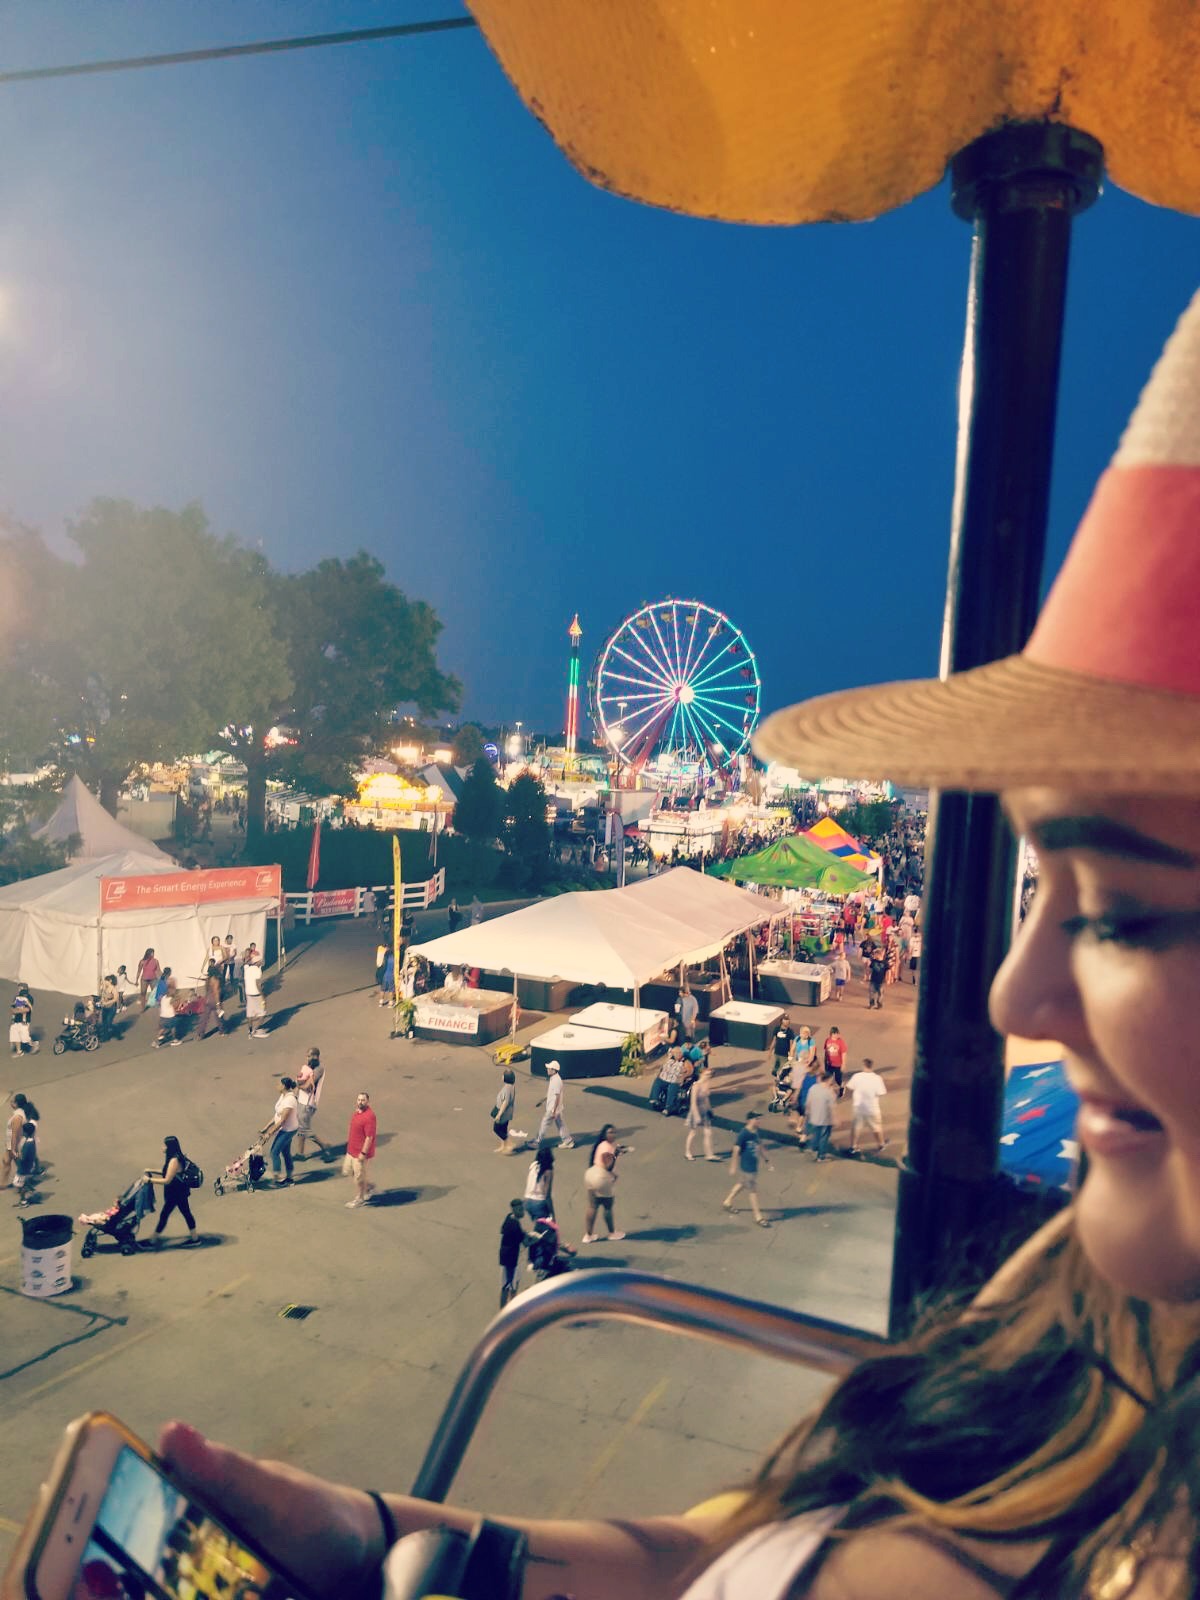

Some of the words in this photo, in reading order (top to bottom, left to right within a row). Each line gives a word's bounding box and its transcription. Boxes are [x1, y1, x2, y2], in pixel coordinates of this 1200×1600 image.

[136, 884, 152, 895] The
[153, 882, 178, 894] Smart
[180, 881, 207, 893] Energy
[208, 878, 247, 890] Experience
[428, 1017, 476, 1031] FINANCE
